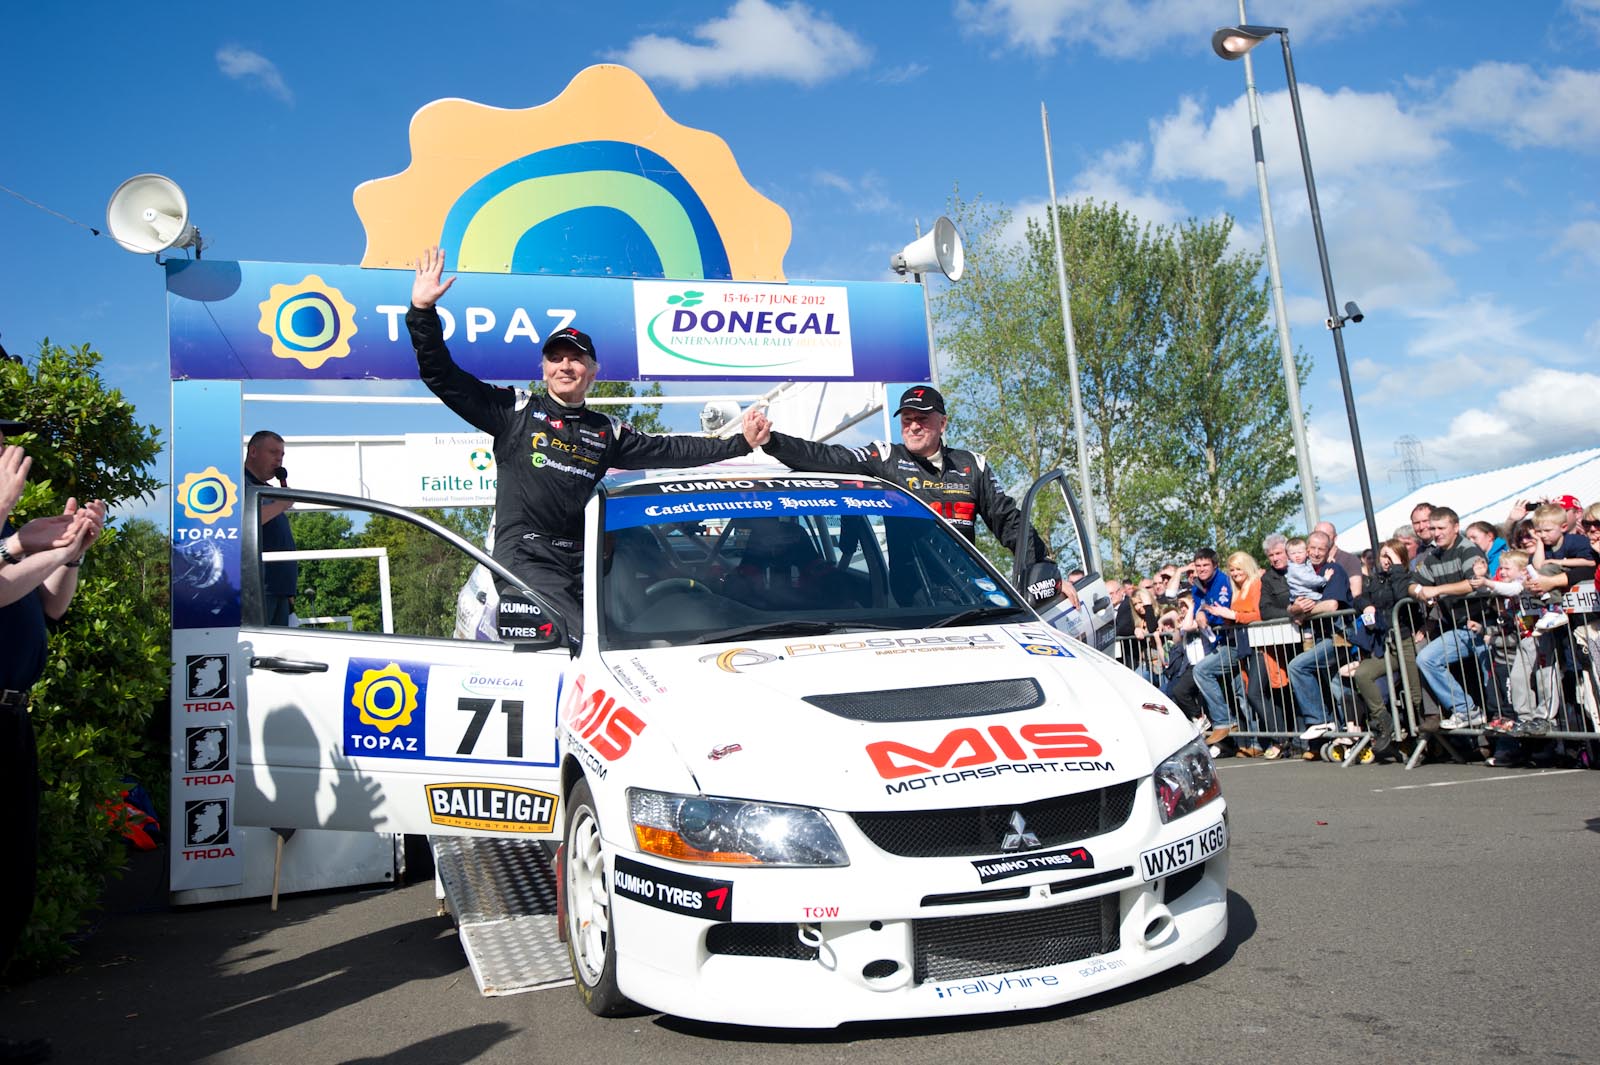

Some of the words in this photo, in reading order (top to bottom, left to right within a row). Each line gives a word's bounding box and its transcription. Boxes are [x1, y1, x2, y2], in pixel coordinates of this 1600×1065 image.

[723, 293, 765, 303] 15-16-17
[769, 294, 798, 305] JUNE
[801, 295, 825, 305] 2012
[672, 310, 841, 335] DONEGAL
[670, 336, 760, 347] INTERNATIONAL
[763, 336, 793, 347] RALLY
[435, 436, 445, 445] In
[659, 480, 754, 493] KUMHO
[758, 479, 839, 489] TYRES
[645, 499, 773, 517] Castlemurray
[778, 496, 837, 510] House
[841, 496, 892, 509] Hotel
[177, 527, 238, 540] TOPAZ
[1027, 578, 1056, 594] KUMHO
[1033, 588, 1056, 600] TYRES
[501, 602, 541, 615] KUMHO
[501, 627, 536, 638] TYRES
[785, 633, 994, 656] ProSpeed
[469, 676, 525, 687] DONEGAL
[183, 701, 235, 713] TROA
[456, 697, 524, 758] 71
[351, 735, 418, 751] TOPAZ
[865, 723, 1103, 780] MIS
[182, 774, 234, 787] TROA
[885, 761, 1115, 795] MOTORSPORT.COM
[432, 789, 552, 822] BAILEIGH
[447, 819, 535, 831] INDUSTRIAL
[182, 847, 235, 861] TROA
[1144, 839, 1194, 876] WX57
[1199, 825, 1224, 856] KGG
[977, 860, 1028, 877] KUMHO
[1028, 854, 1073, 867] TYRES
[615, 869, 655, 898] KUMHO
[656, 883, 703, 910] TYRES
[803, 906, 839, 918] TOW
[947, 974, 1059, 997] rallyhire
